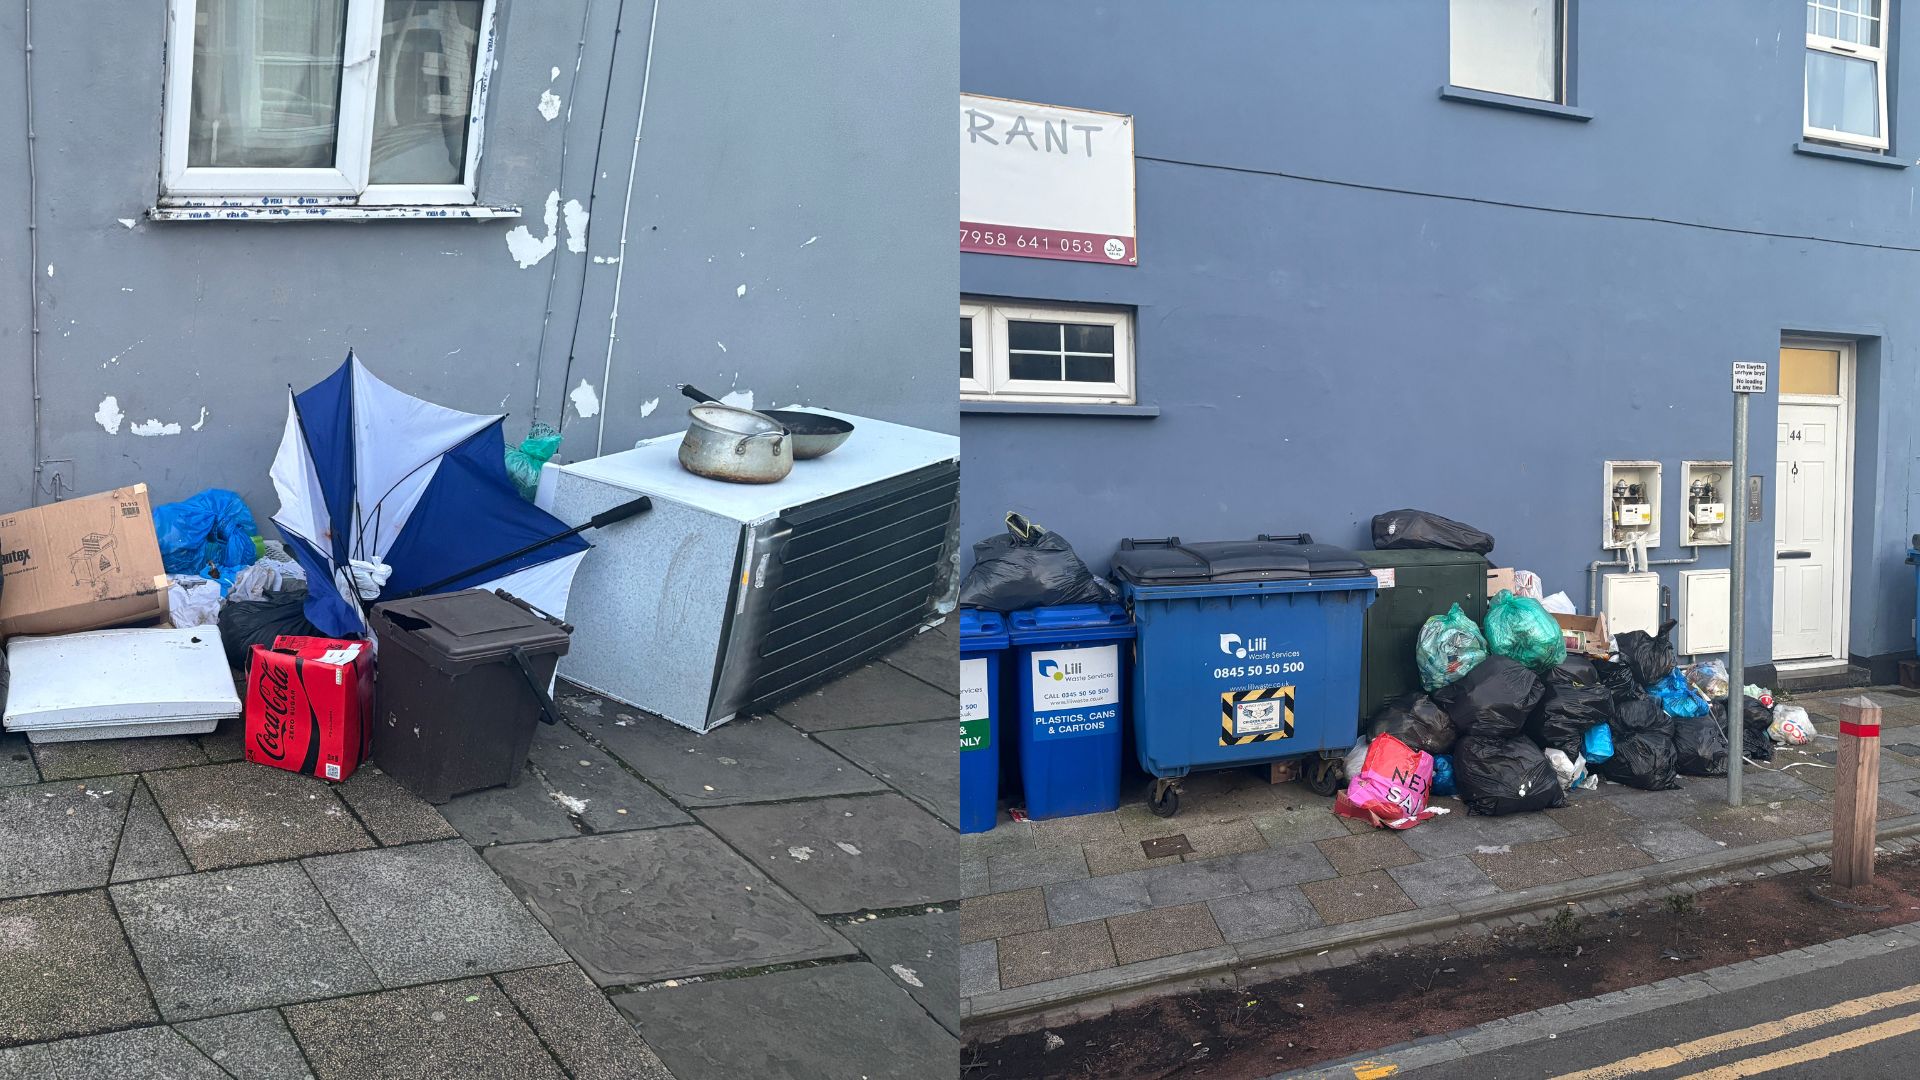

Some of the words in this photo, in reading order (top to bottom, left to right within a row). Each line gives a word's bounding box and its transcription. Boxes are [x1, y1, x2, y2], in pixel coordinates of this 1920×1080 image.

[964, 108, 1103, 157] RANT
[1016, 235, 1049, 250] 641
[1060, 238, 1094, 254] 053
[1790, 430, 1801, 440] 44
[1248, 638, 1266, 652] Lili
[1065, 662, 1082, 675] Lili
[1214, 668, 1244, 679] 0845
[1248, 666, 1262, 676] 50
[1265, 664, 1280, 674] 50
[1282, 662, 1304, 672] 500
[1087, 672, 1114, 681] Services
[256, 658, 289, 761] Coca-Cola
[1035, 714, 1086, 725] PLASTICS,
[1089, 710, 1116, 720] CANS
[1058, 722, 1105, 733] CARTONS
